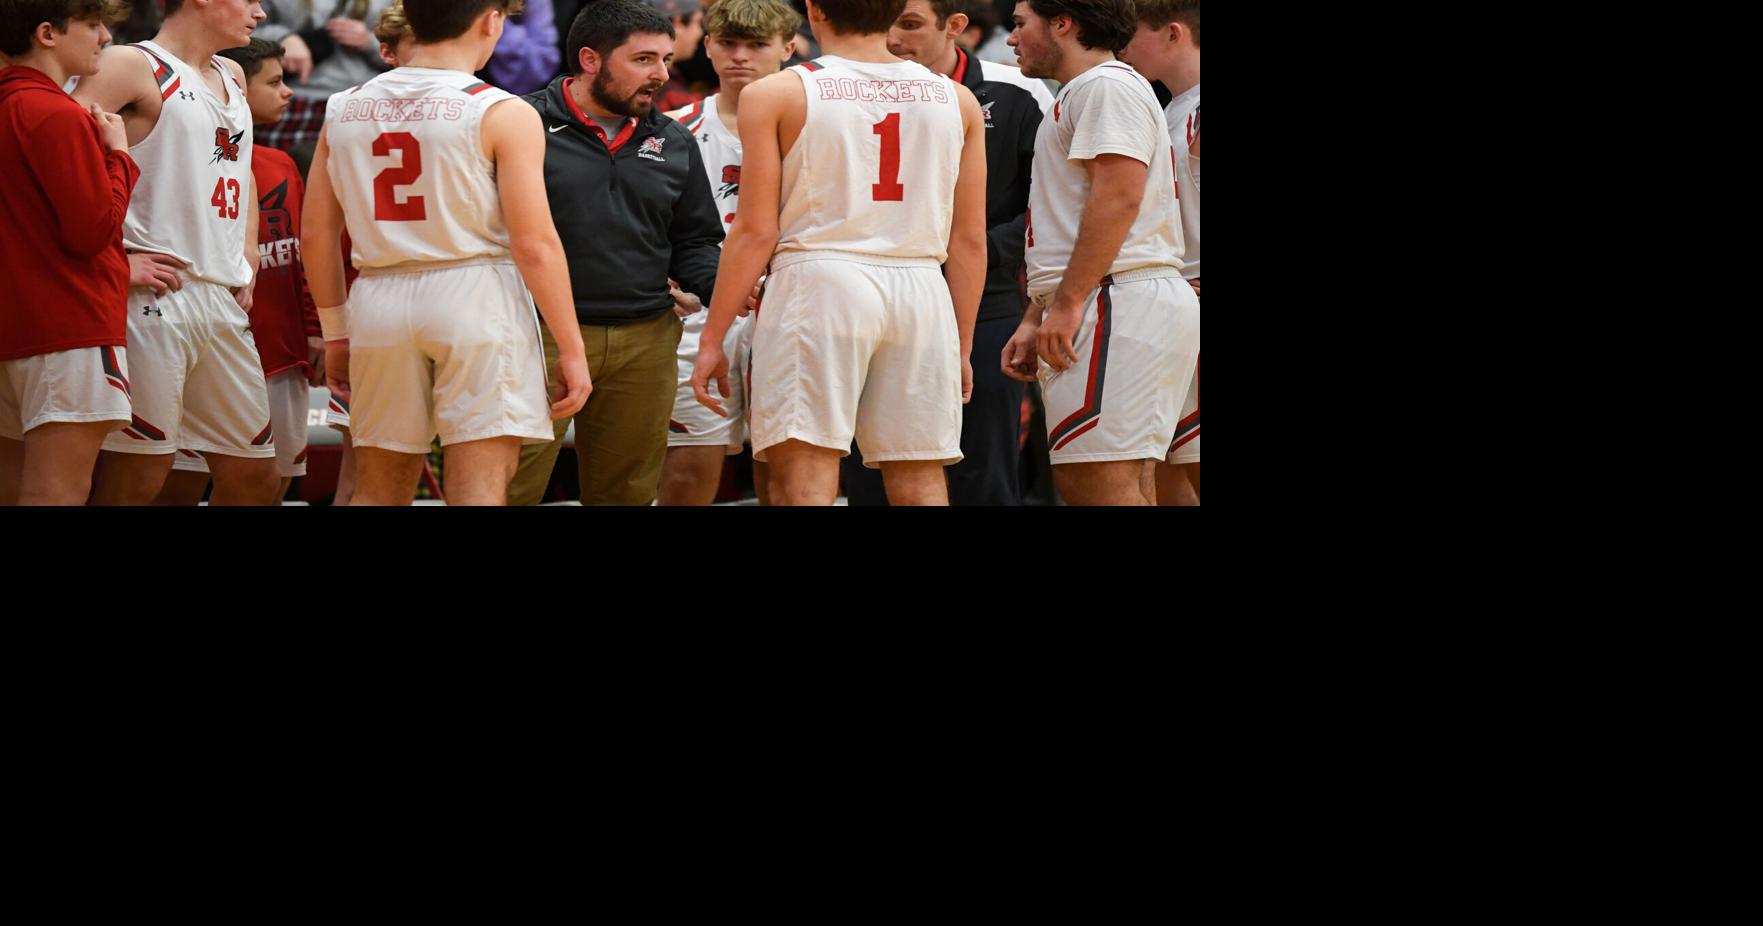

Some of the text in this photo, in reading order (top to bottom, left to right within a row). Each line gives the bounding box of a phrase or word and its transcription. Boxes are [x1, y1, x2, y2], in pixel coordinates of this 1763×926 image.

[340, 97, 465, 123] ROCKETS
[816, 78, 949, 104] ROCKETS
[372, 131, 427, 221] 2
[871, 112, 904, 202] 1
[210, 176, 240, 220] 43
